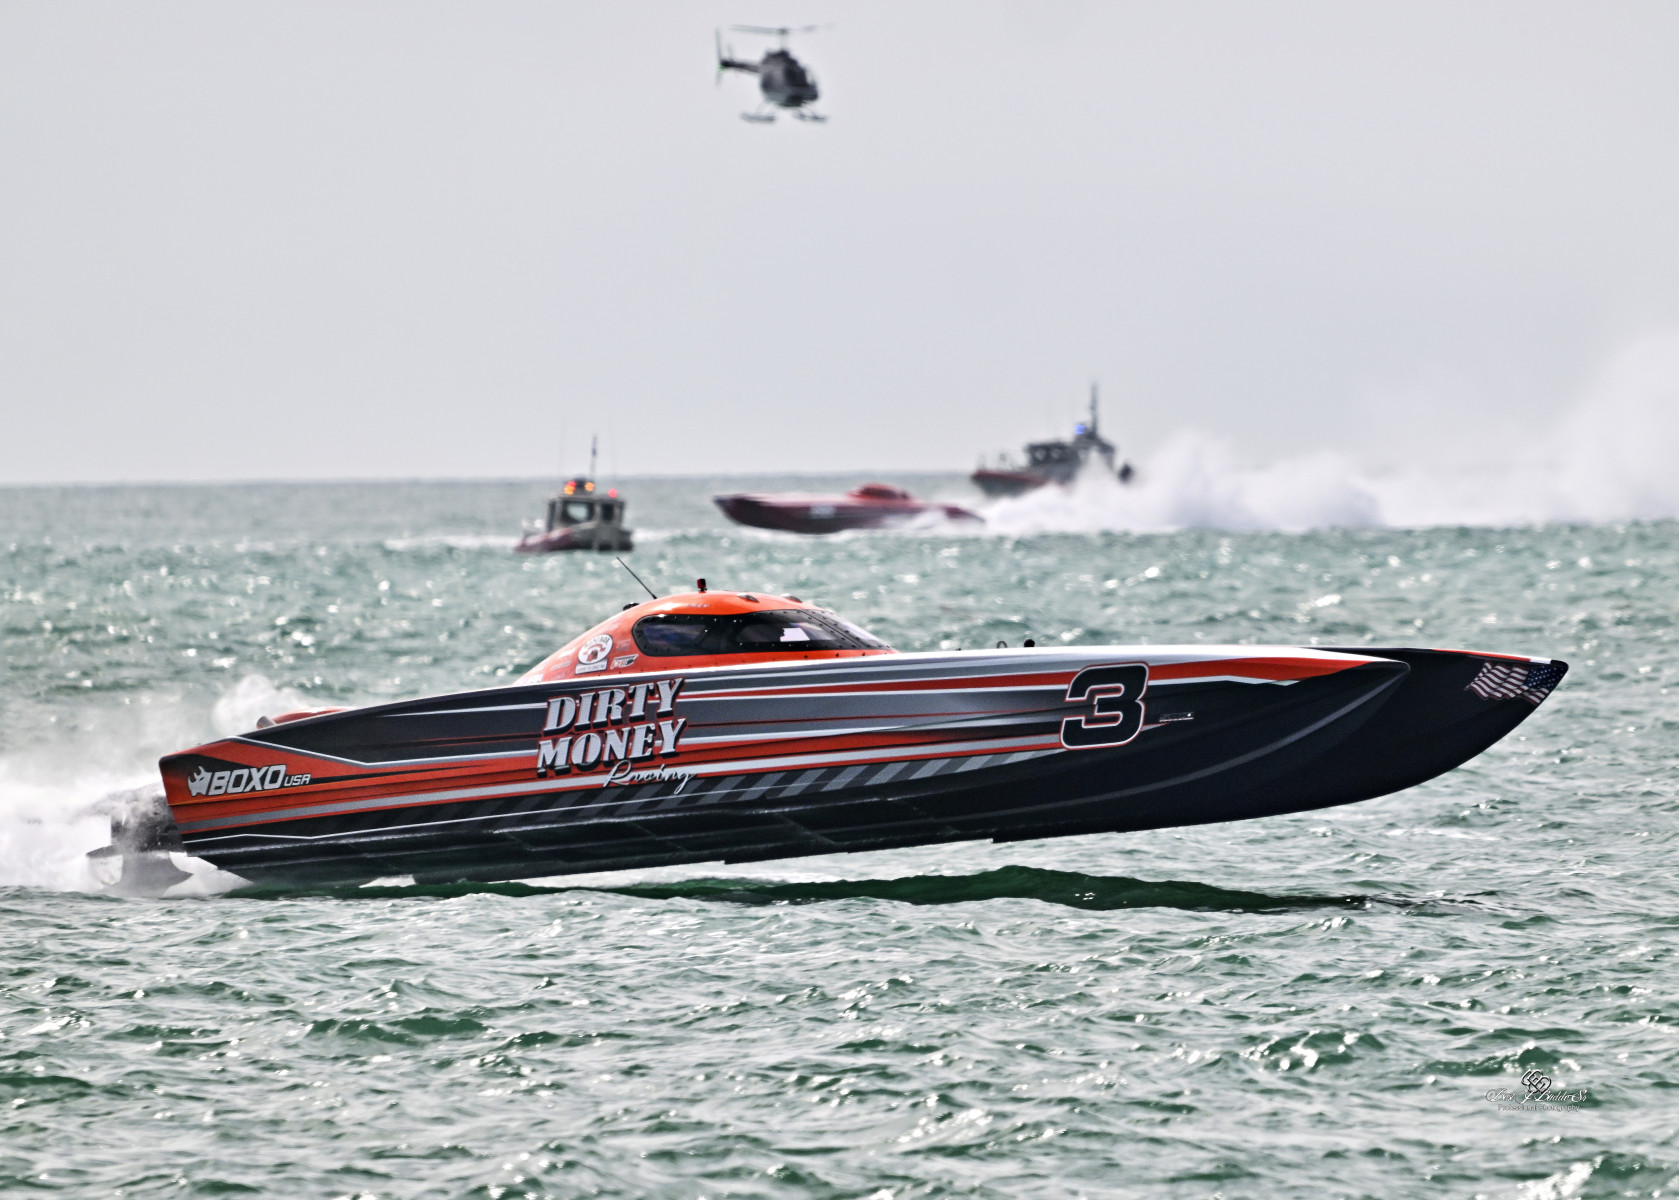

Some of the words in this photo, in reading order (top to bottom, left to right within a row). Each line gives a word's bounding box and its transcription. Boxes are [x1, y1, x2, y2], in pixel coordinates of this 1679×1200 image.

[543, 677, 686, 735] DIRTY
[1060, 660, 1149, 750] 3
[537, 718, 687, 777] MONEY
[208, 764, 287, 796] BOXO
[284, 773, 311, 787] USA
[603, 759, 697, 795] Racing
